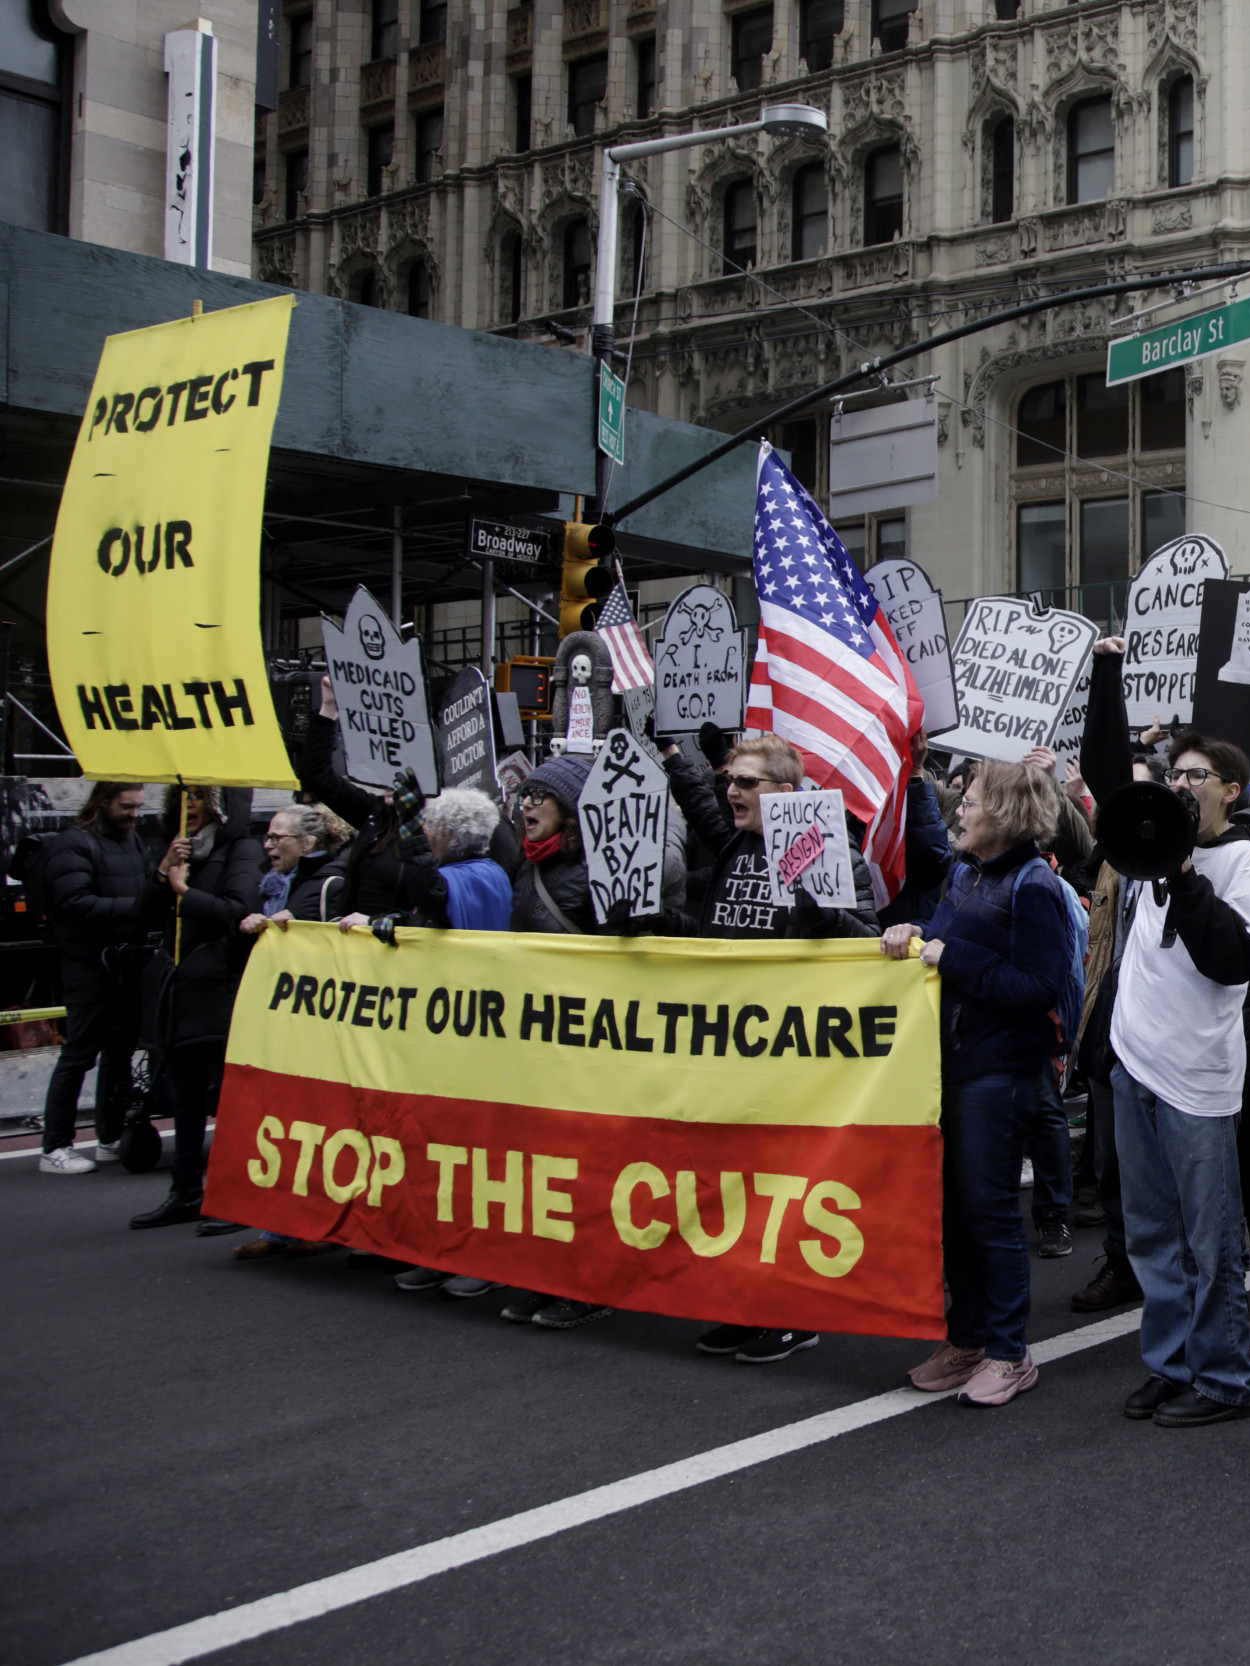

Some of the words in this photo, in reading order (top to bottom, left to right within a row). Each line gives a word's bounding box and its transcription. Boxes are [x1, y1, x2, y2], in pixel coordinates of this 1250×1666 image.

[1141, 327, 1202, 365] Barclay
[1208, 316, 1225, 344] St
[88, 359, 275, 441] PROTECT
[98, 520, 195, 577] OUR
[478, 529, 542, 560] Broadway
[1135, 583, 1205, 616] CANCE
[960, 637, 1007, 660] DIED
[1006, 648, 1074, 679] ALONE
[1126, 628, 1200, 665] RESEARC
[332, 659, 415, 696] MEDICAID
[573, 689, 587, 699] NO
[663, 672, 700, 689] DEATH
[706, 668, 739, 684] FROM
[956, 662, 1068, 706] ALZHEIMERS
[77, 679, 257, 731] HEALTH
[360, 688, 404, 718] CUTS
[346, 707, 415, 743] KILLED
[447, 717, 478, 751] AFFORD
[477, 712, 486, 729] A
[959, 704, 1048, 747] AREGIVER
[369, 737, 402, 767] ME
[450, 739, 486, 774] DOCTOR
[583, 792, 661, 853] DEATH
[602, 840, 640, 877] BY
[778, 826, 821, 883] RESIGN
[590, 862, 657, 920] DOGE
[725, 878, 772, 903] THE
[811, 863, 840, 898] US!
[711, 902, 778, 930] RICH
[269, 971, 418, 1032] PROTECT
[425, 987, 507, 1040] OUR
[519, 993, 898, 1058] HEALTHCARE
[247, 1115, 405, 1208] STOP
[427, 1143, 578, 1243] THE
[611, 1161, 865, 1279] CUTS
